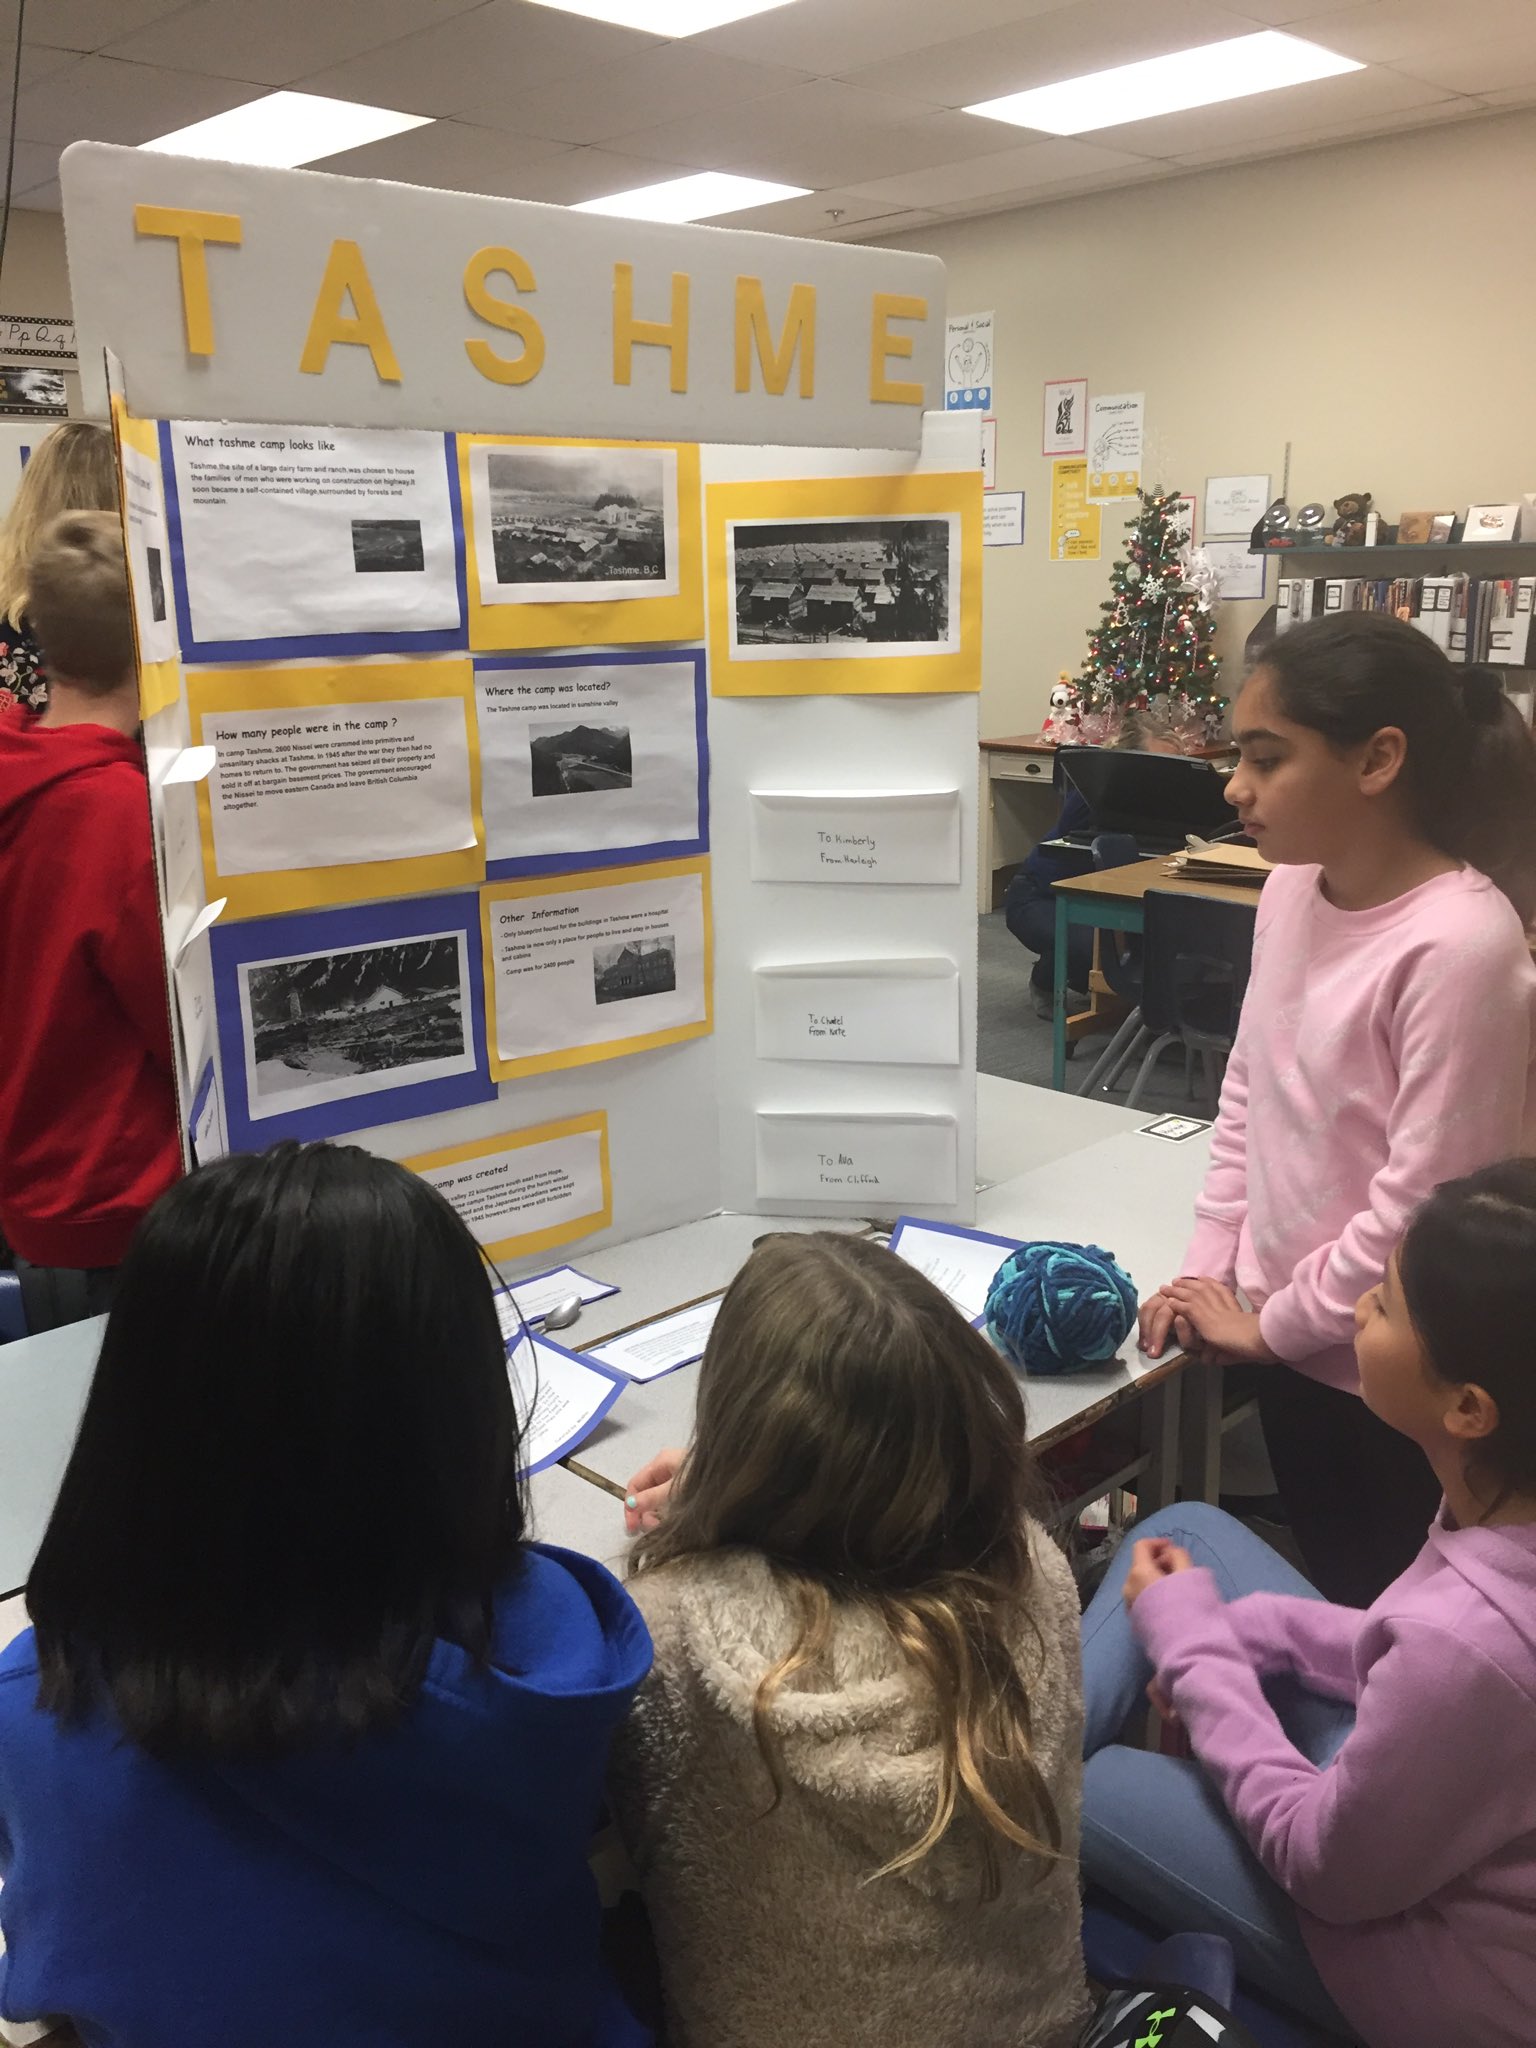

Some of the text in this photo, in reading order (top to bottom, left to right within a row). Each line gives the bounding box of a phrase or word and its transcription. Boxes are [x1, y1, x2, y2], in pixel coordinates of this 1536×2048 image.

[135, 204, 929, 405] TASHME
[1096, 401, 1138, 412] Communication
[185, 436, 335, 451] What tashme camp looks like
[232, 463, 244, 471] site
[261, 464, 277, 473] large
[279, 465, 294, 473] dairy
[204, 474, 230, 482] families
[294, 476, 320, 485] working
[485, 682, 611, 696] Where the camp was located?
[499, 704, 520, 712] Tashme
[522, 704, 536, 712] camp
[550, 701, 570, 709] located
[216, 731, 237, 740] How
[242, 730, 267, 739] many
[272, 725, 301, 738] people
[306, 725, 328, 733] were
[345, 721, 360, 730] the
[365, 720, 388, 730] camp
[331, 739, 360, 748] crammed
[375, 737, 402, 745] primitive
[219, 760, 253, 768] unsanitary
[299, 762, 336, 771] government
[397, 754, 422, 763] property
[263, 778, 287, 786] bargain
[289, 774, 320, 782] basement
[358, 767, 395, 776] government
[396, 764, 431, 772] encouraged
[311, 783, 335, 791] Canada
[368, 777, 388, 785] British
[389, 775, 417, 783] Columbia
[818, 831, 875, 850] To Kimberly
[820, 852, 842, 863] From
[500, 907, 579, 924] Other Information
[518, 928, 542, 936] blueprint
[557, 959, 575, 967] people
[808, 1014, 818, 1024] To
[809, 1026, 826, 1036] From
[817, 1154, 833, 1166] To
[433, 1164, 508, 1189] camp was created
[820, 1174, 842, 1183] From
